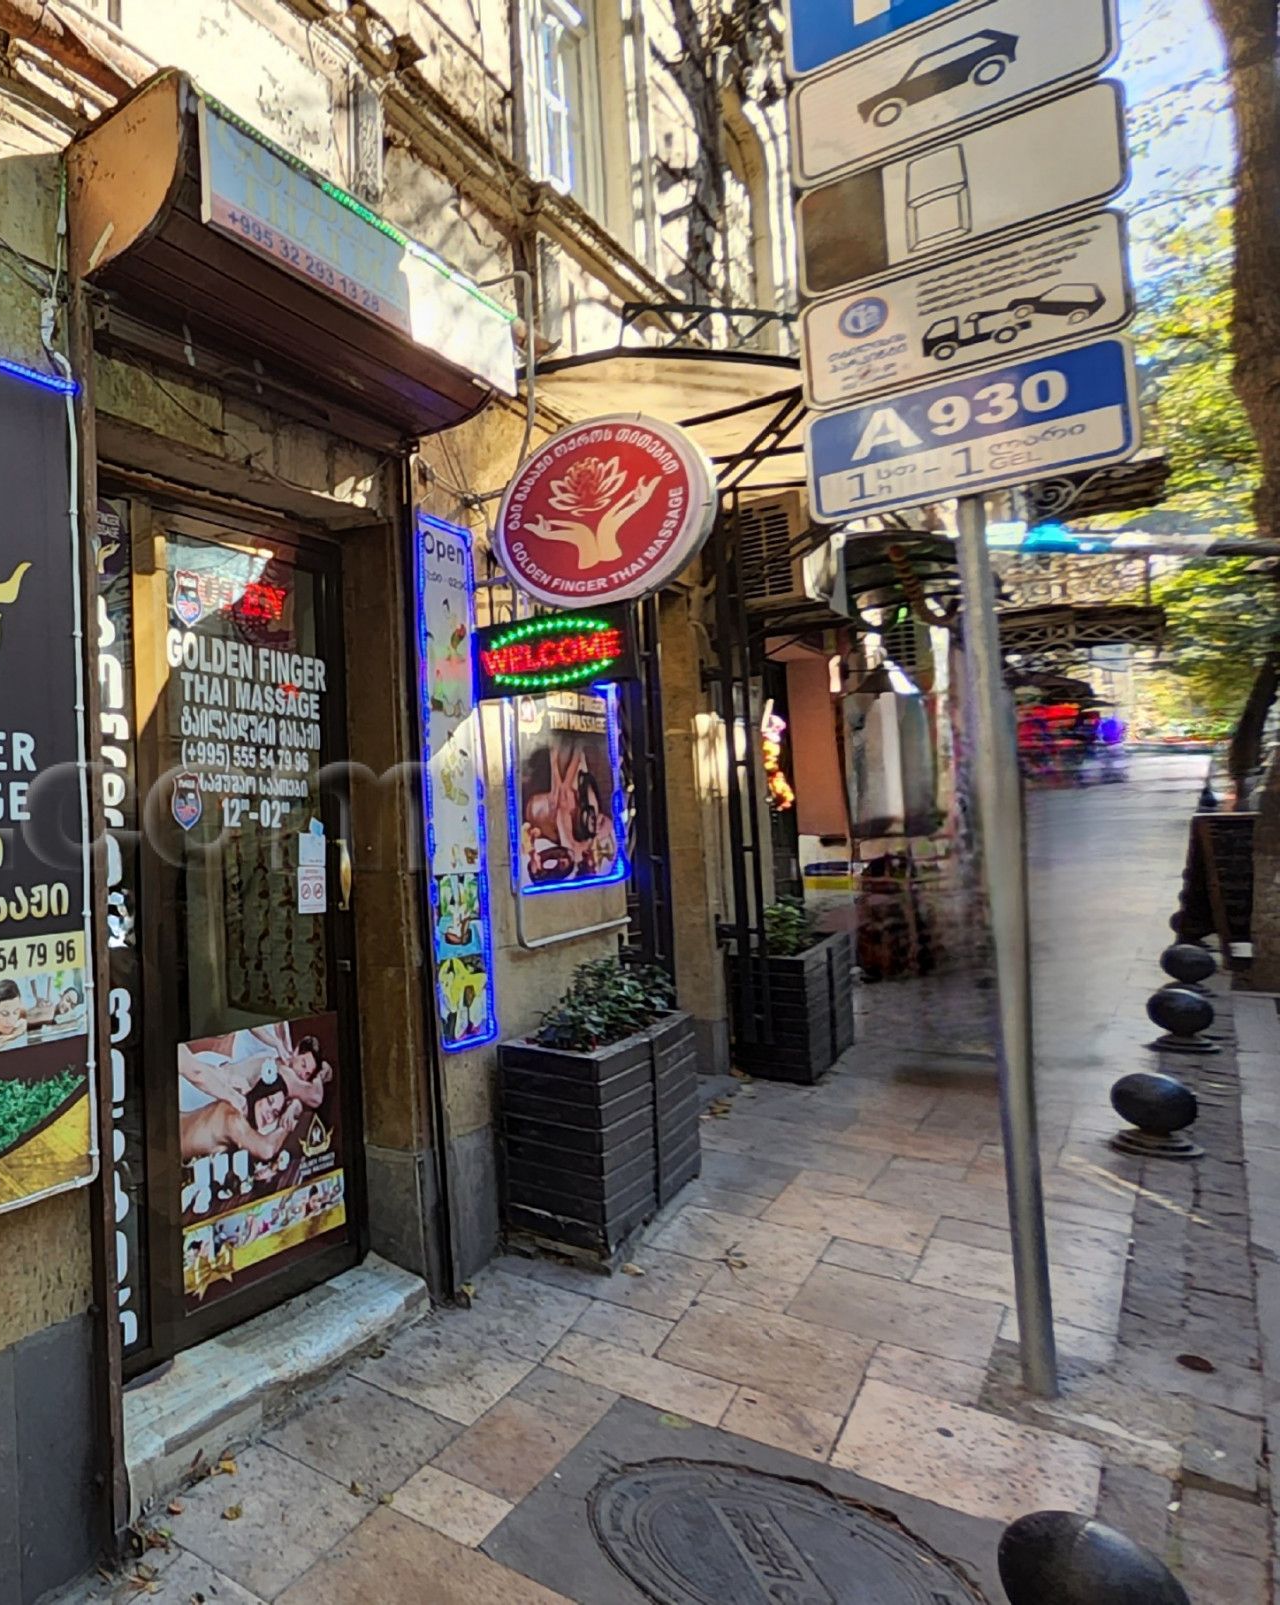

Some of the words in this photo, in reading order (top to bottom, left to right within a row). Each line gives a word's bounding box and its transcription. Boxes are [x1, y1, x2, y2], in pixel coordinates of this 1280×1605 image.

[228, 209, 273, 249] +995
[280, 239, 300, 264] 32
[306, 253, 334, 287] 293
[340, 277, 357, 301] 13
[951, 446, 984, 479] 1
[990, 449, 1041, 472] GEL
[422, 531, 465, 566] Open
[511, 541, 553, 586] GOLDEN
[551, 577, 608, 592] FINGER
[610, 557, 646, 586] THAI
[644, 486, 685, 561] MASSAGE
[166, 628, 253, 680] GOLDEN
[258, 648, 327, 692] FINGER
[481, 628, 621, 677] WELCOME
[180, 671, 229, 707] THAI
[235, 681, 320, 721] MASSAGE
[181, 738, 230, 773] (+995)
[233, 745, 256, 768] 555
[259, 748, 275, 770] 54
[278, 750, 291, 772] 79
[295, 751, 309, 773] 96
[26, 941, 48, 969] 79
[54, 937, 76, 965] 96
